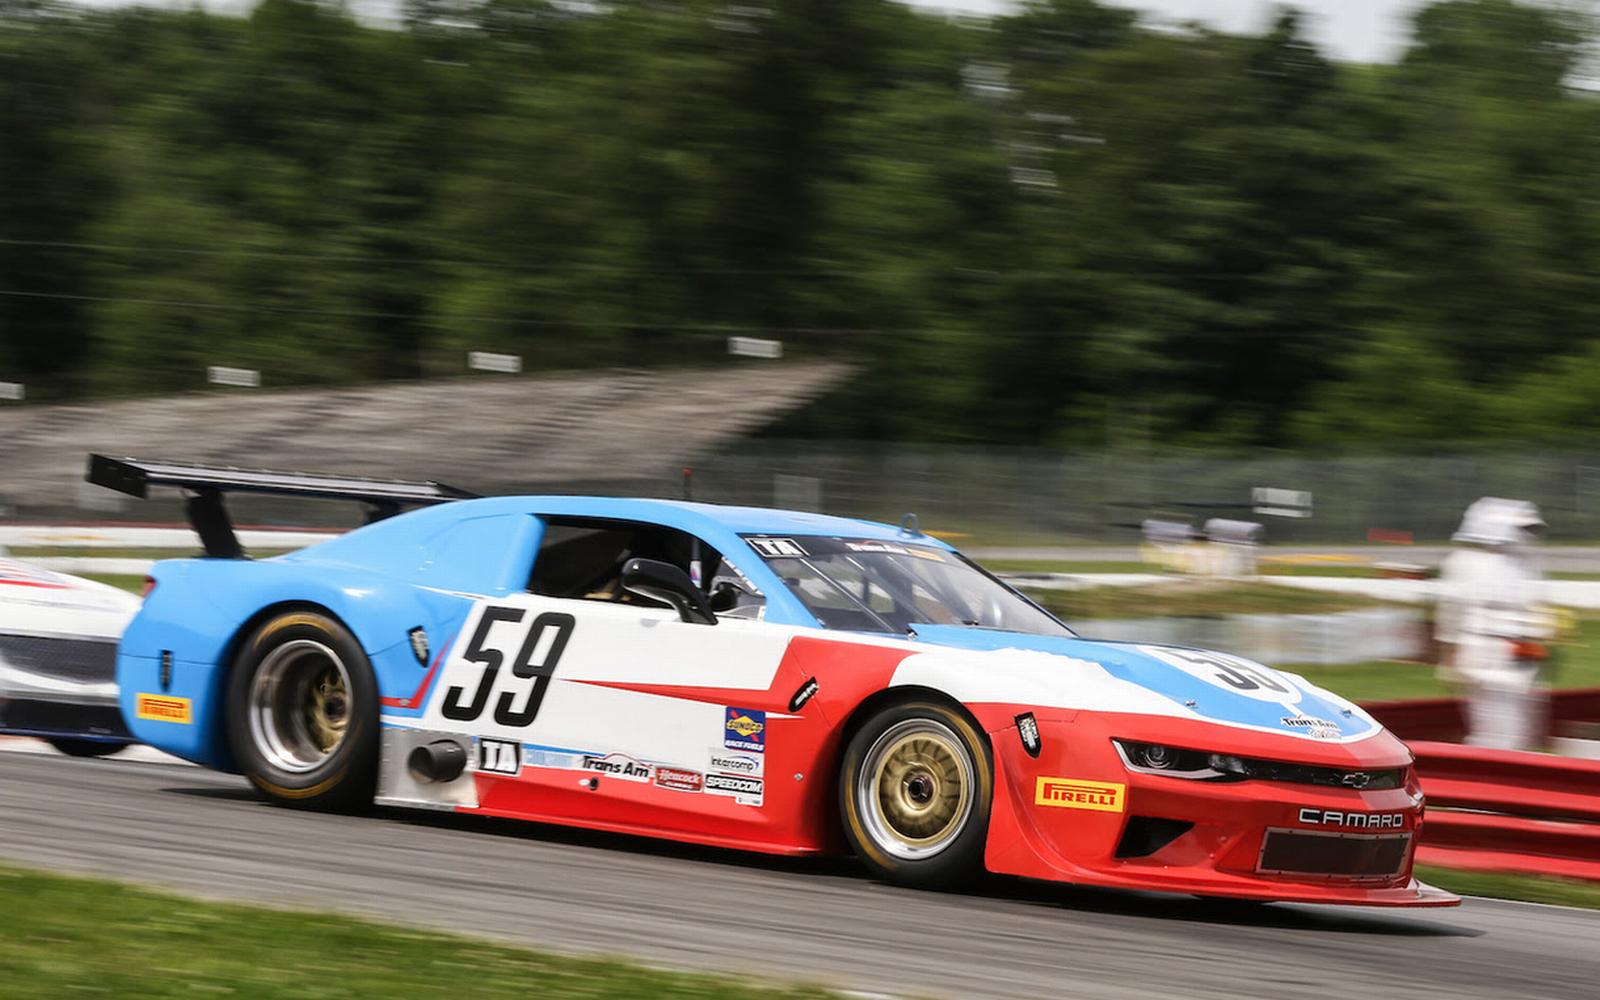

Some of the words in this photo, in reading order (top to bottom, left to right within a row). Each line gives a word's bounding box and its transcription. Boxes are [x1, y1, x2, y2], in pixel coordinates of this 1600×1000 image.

[752, 539, 801, 555] TA
[441, 605, 576, 727] 59
[143, 698, 185, 719] PIRELLI
[726, 720, 764, 732] SUNOCO
[482, 740, 517, 772] TA
[582, 755, 622, 773] Trans
[623, 761, 649, 778] Am
[1043, 782, 1117, 806] PIRELLI
[1299, 808, 1403, 828] CAMARO
